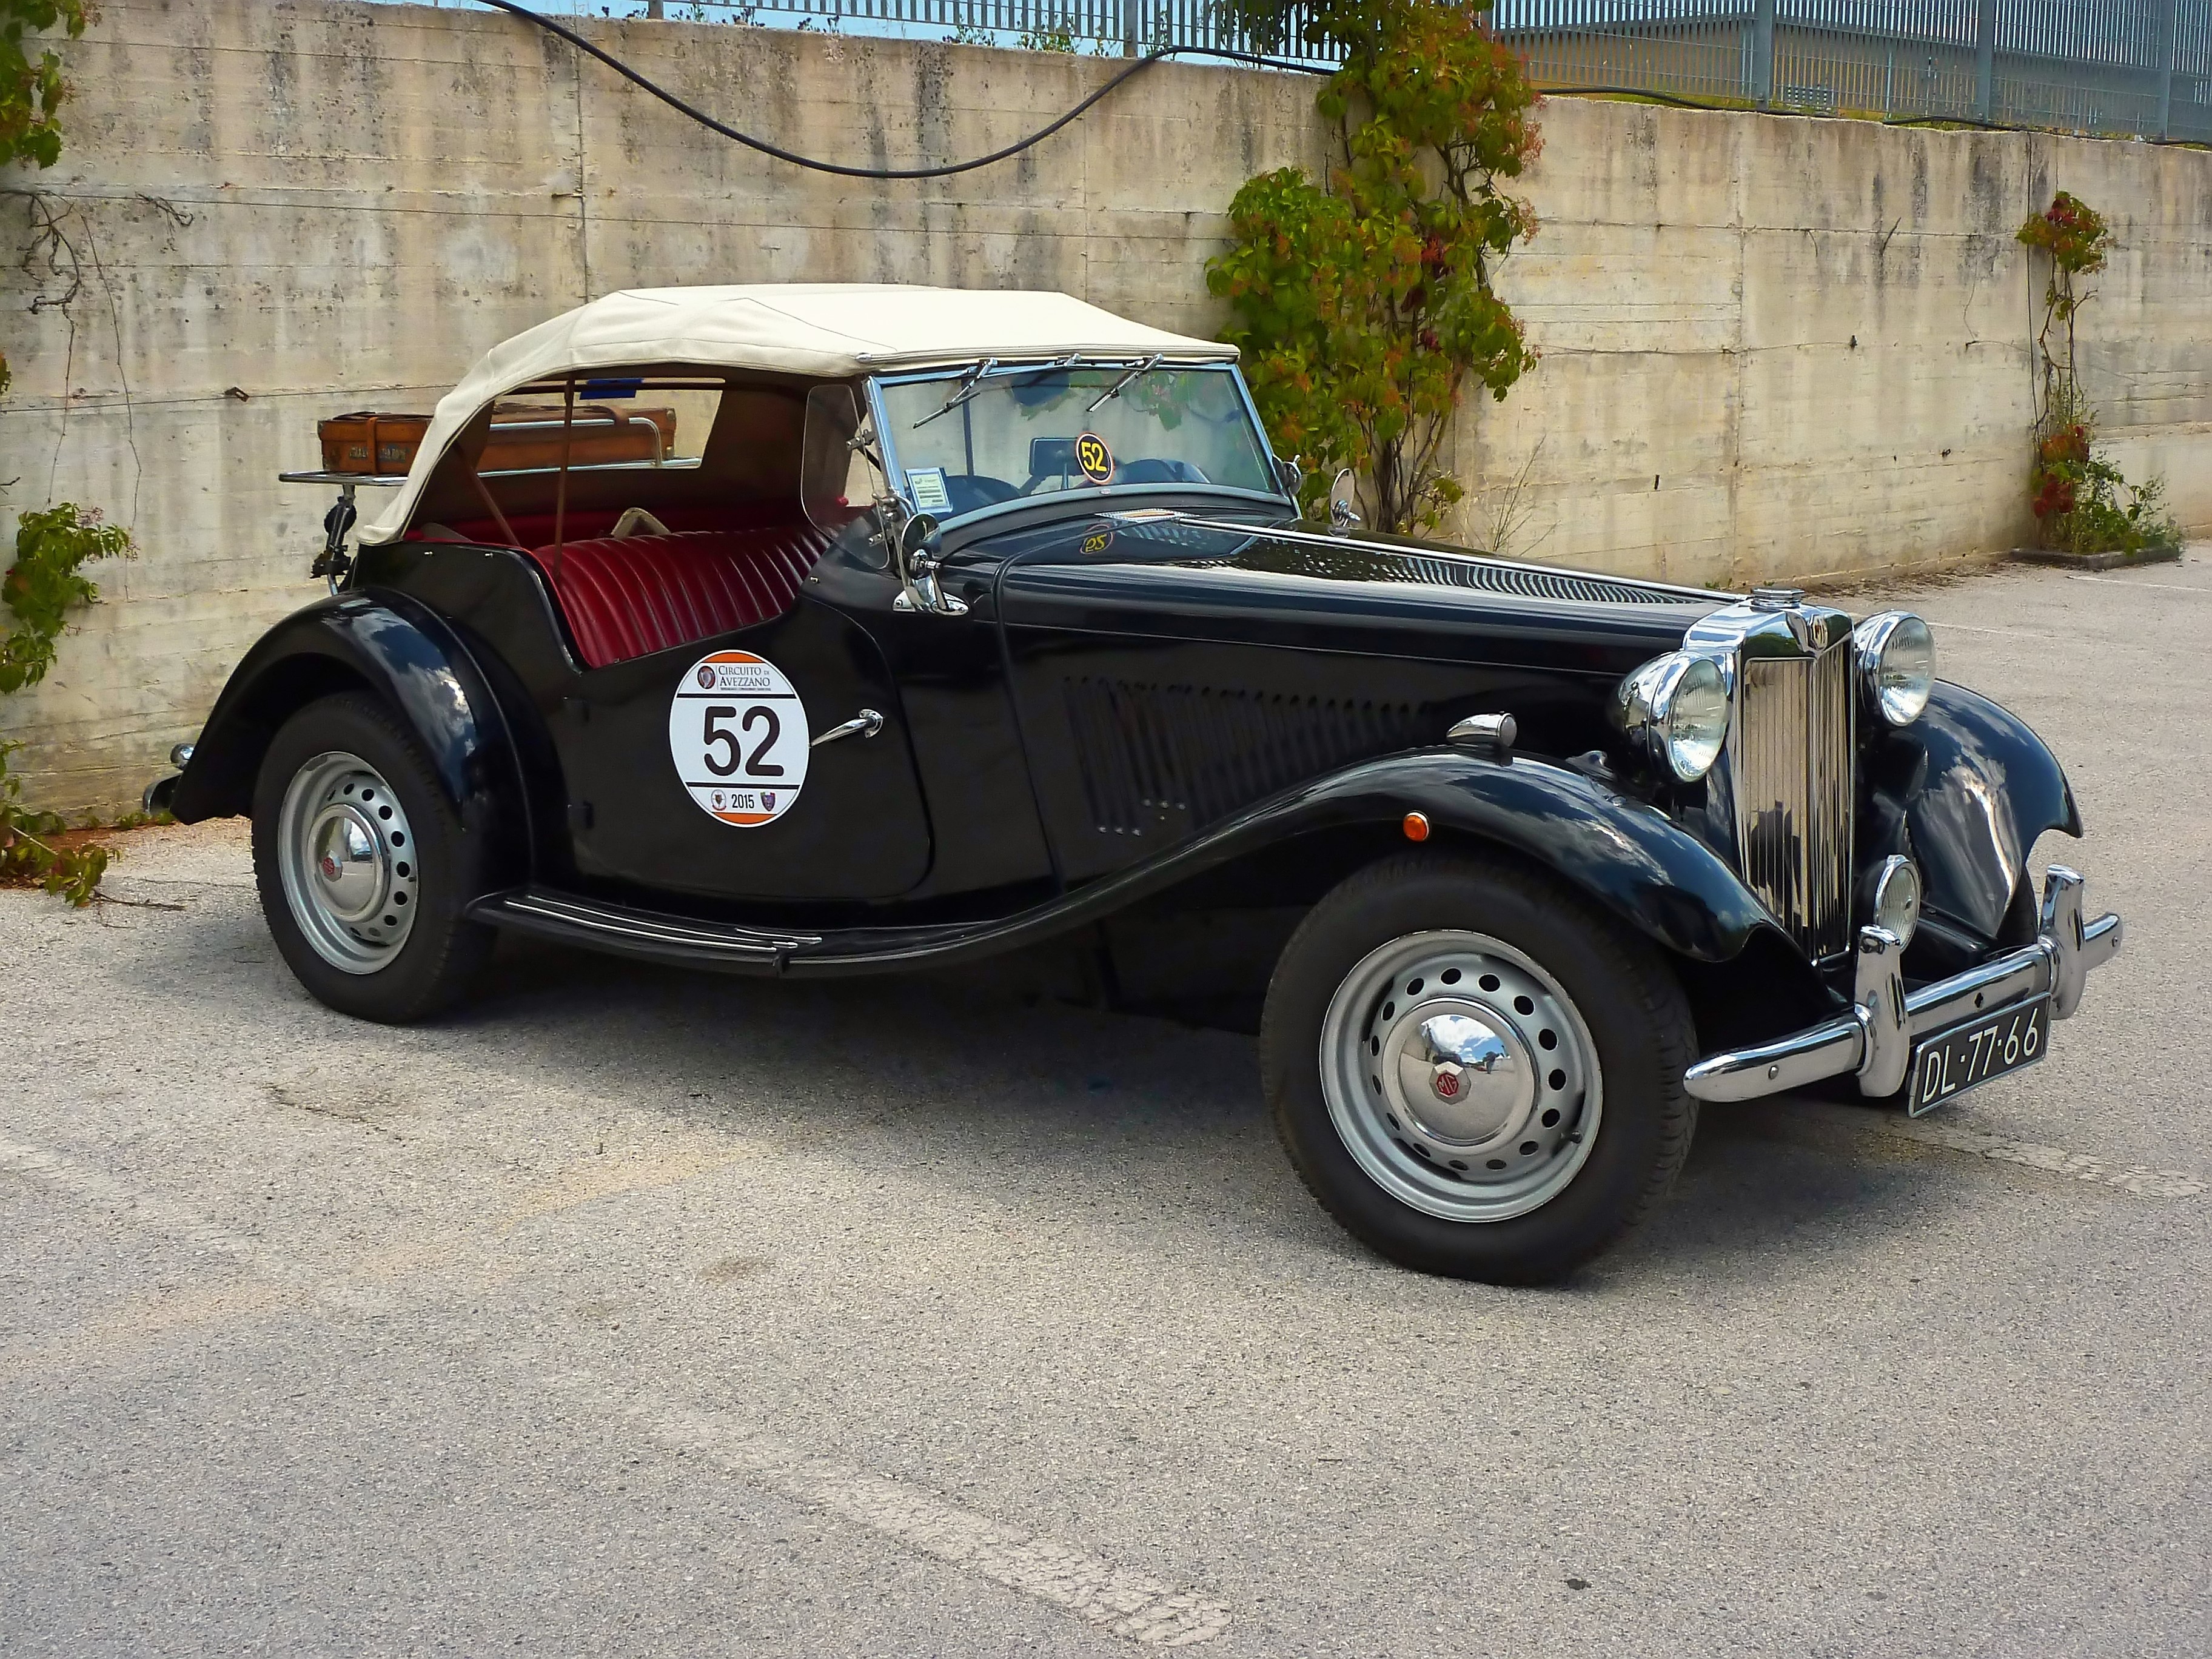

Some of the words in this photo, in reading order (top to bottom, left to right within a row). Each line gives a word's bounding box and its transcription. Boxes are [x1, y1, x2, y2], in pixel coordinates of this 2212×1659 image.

[1081, 441, 1107, 471] 52
[718, 665, 762, 675] CIRCUITO
[720, 676, 770, 686] AVEZZANO
[704, 705, 785, 777] 52
[731, 794, 755, 809] 2015
[1438, 1073, 1458, 1094] MG
